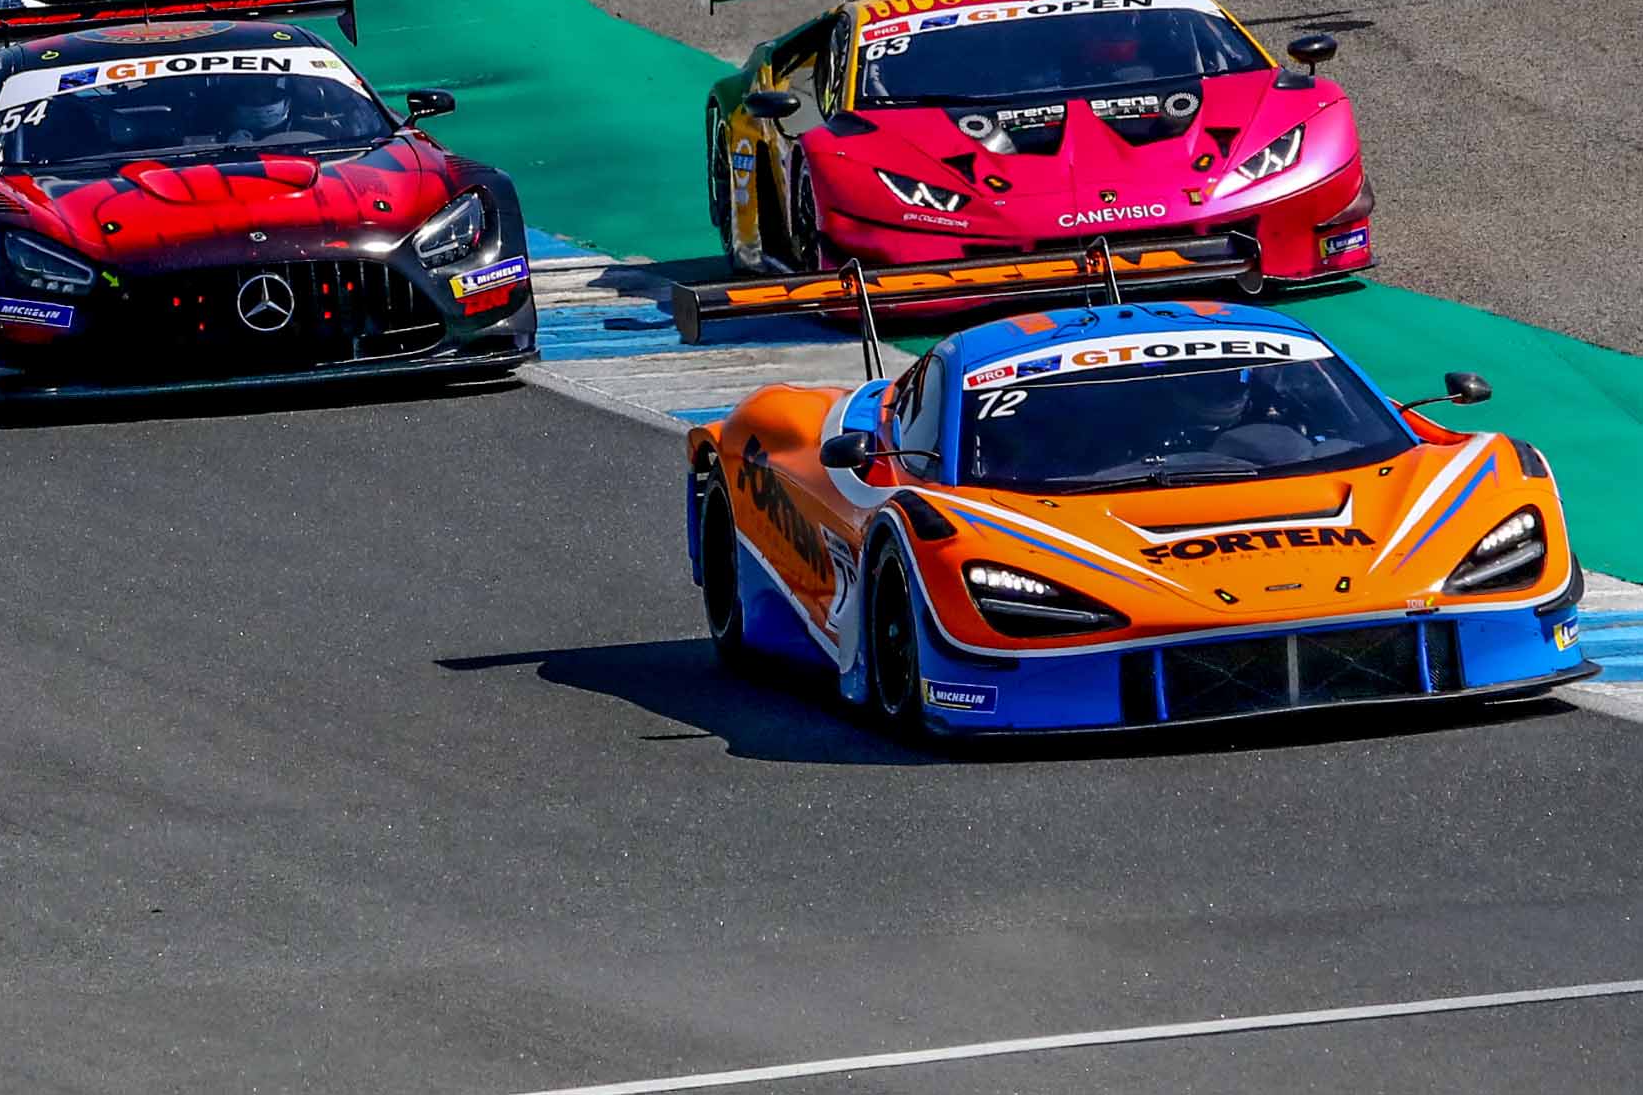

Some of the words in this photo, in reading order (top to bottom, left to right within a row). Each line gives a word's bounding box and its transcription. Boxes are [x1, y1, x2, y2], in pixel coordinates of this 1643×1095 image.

[873, 26, 899, 37] PRO
[865, 37, 911, 61] 63
[106, 56, 292, 81] GTOPEN
[997, 105, 1065, 121] Brena
[1090, 95, 1158, 109] Brena
[2, 100, 47, 134] 54
[1058, 204, 1166, 228] CANEVISIO
[477, 263, 522, 285] MICHELIN
[0, 305, 61, 320] MICHELIN
[1071, 340, 1291, 367] GTOPEN
[975, 367, 1006, 384] PRO
[977, 389, 1028, 420] 72
[1140, 527, 1376, 565] FORTEM
[936, 690, 986, 704] MICHELIN
